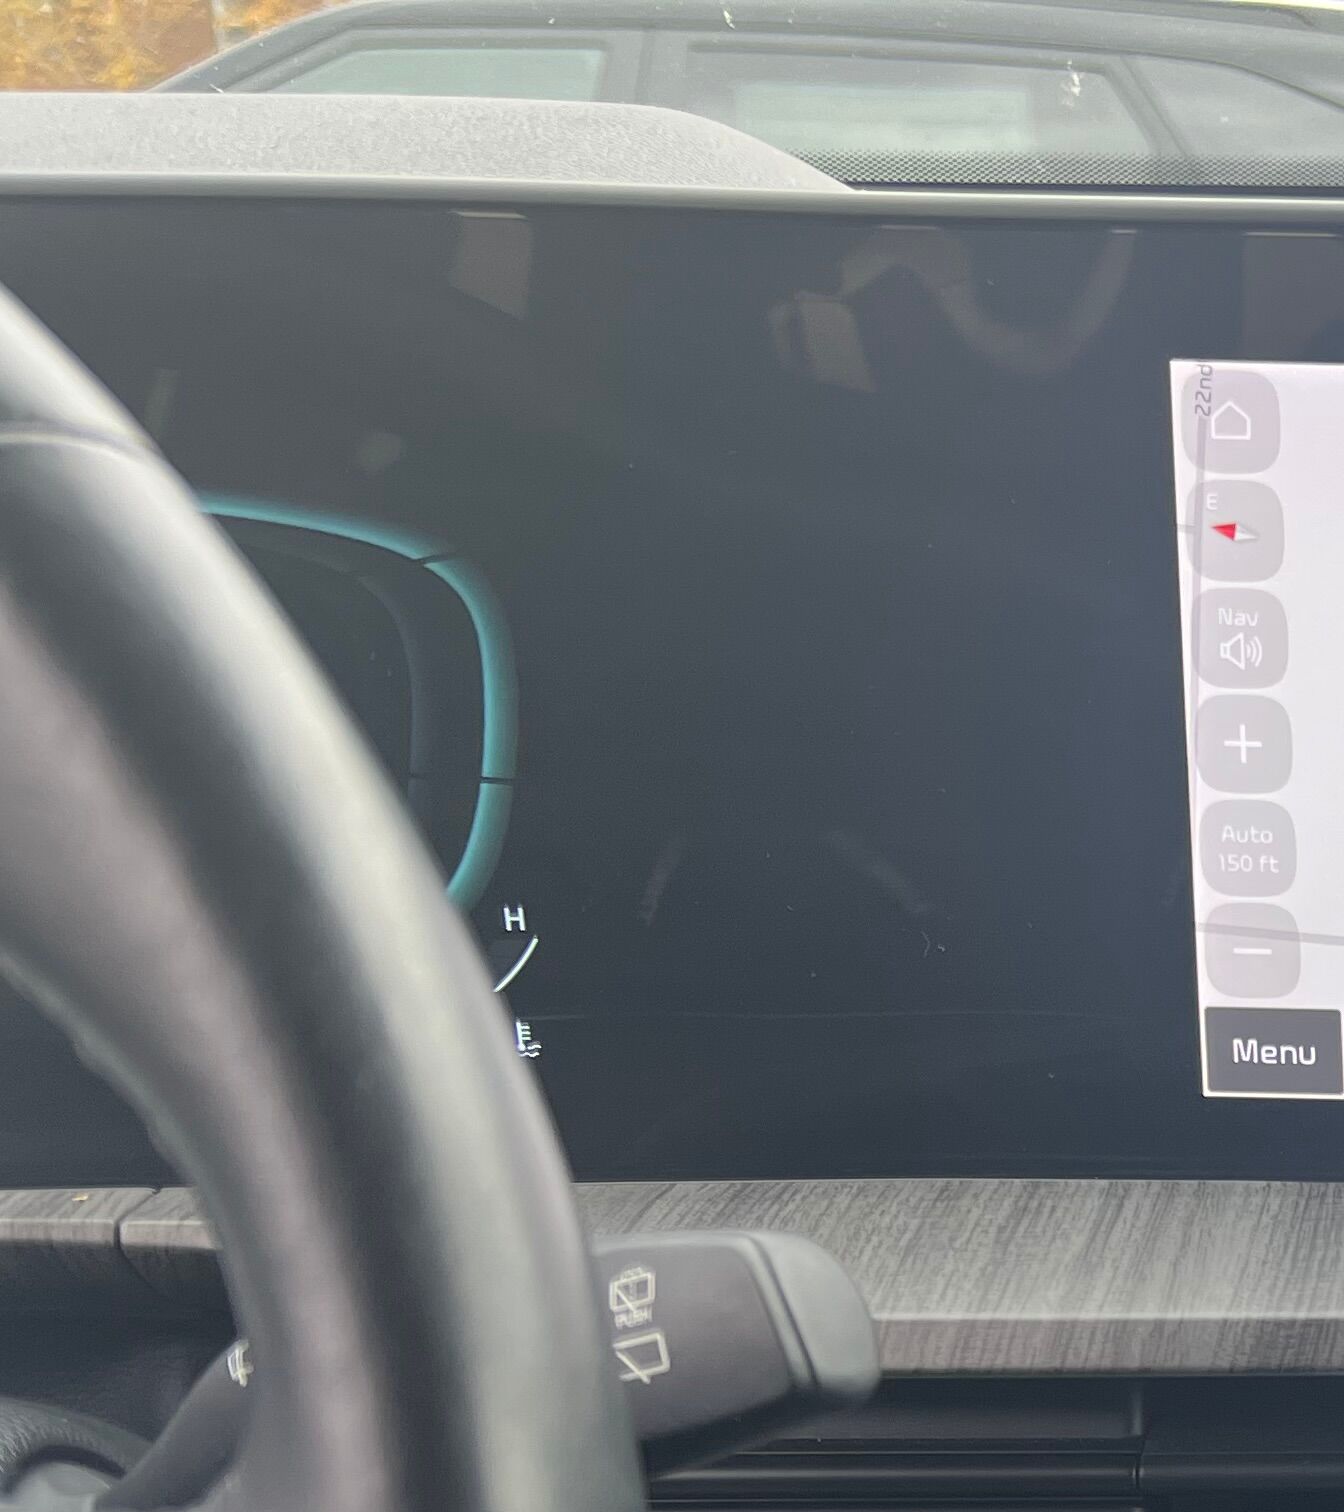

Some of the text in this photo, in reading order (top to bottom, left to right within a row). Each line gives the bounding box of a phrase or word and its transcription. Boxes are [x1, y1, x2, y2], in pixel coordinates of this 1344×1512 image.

[1195, 363, 1213, 416] 22nd
[1217, 606, 1259, 627] Nav
[1220, 824, 1273, 846] Auto
[1219, 853, 1279, 874] 150 ft
[503, 906, 525, 932] H
[1232, 1038, 1316, 1066] Menu
